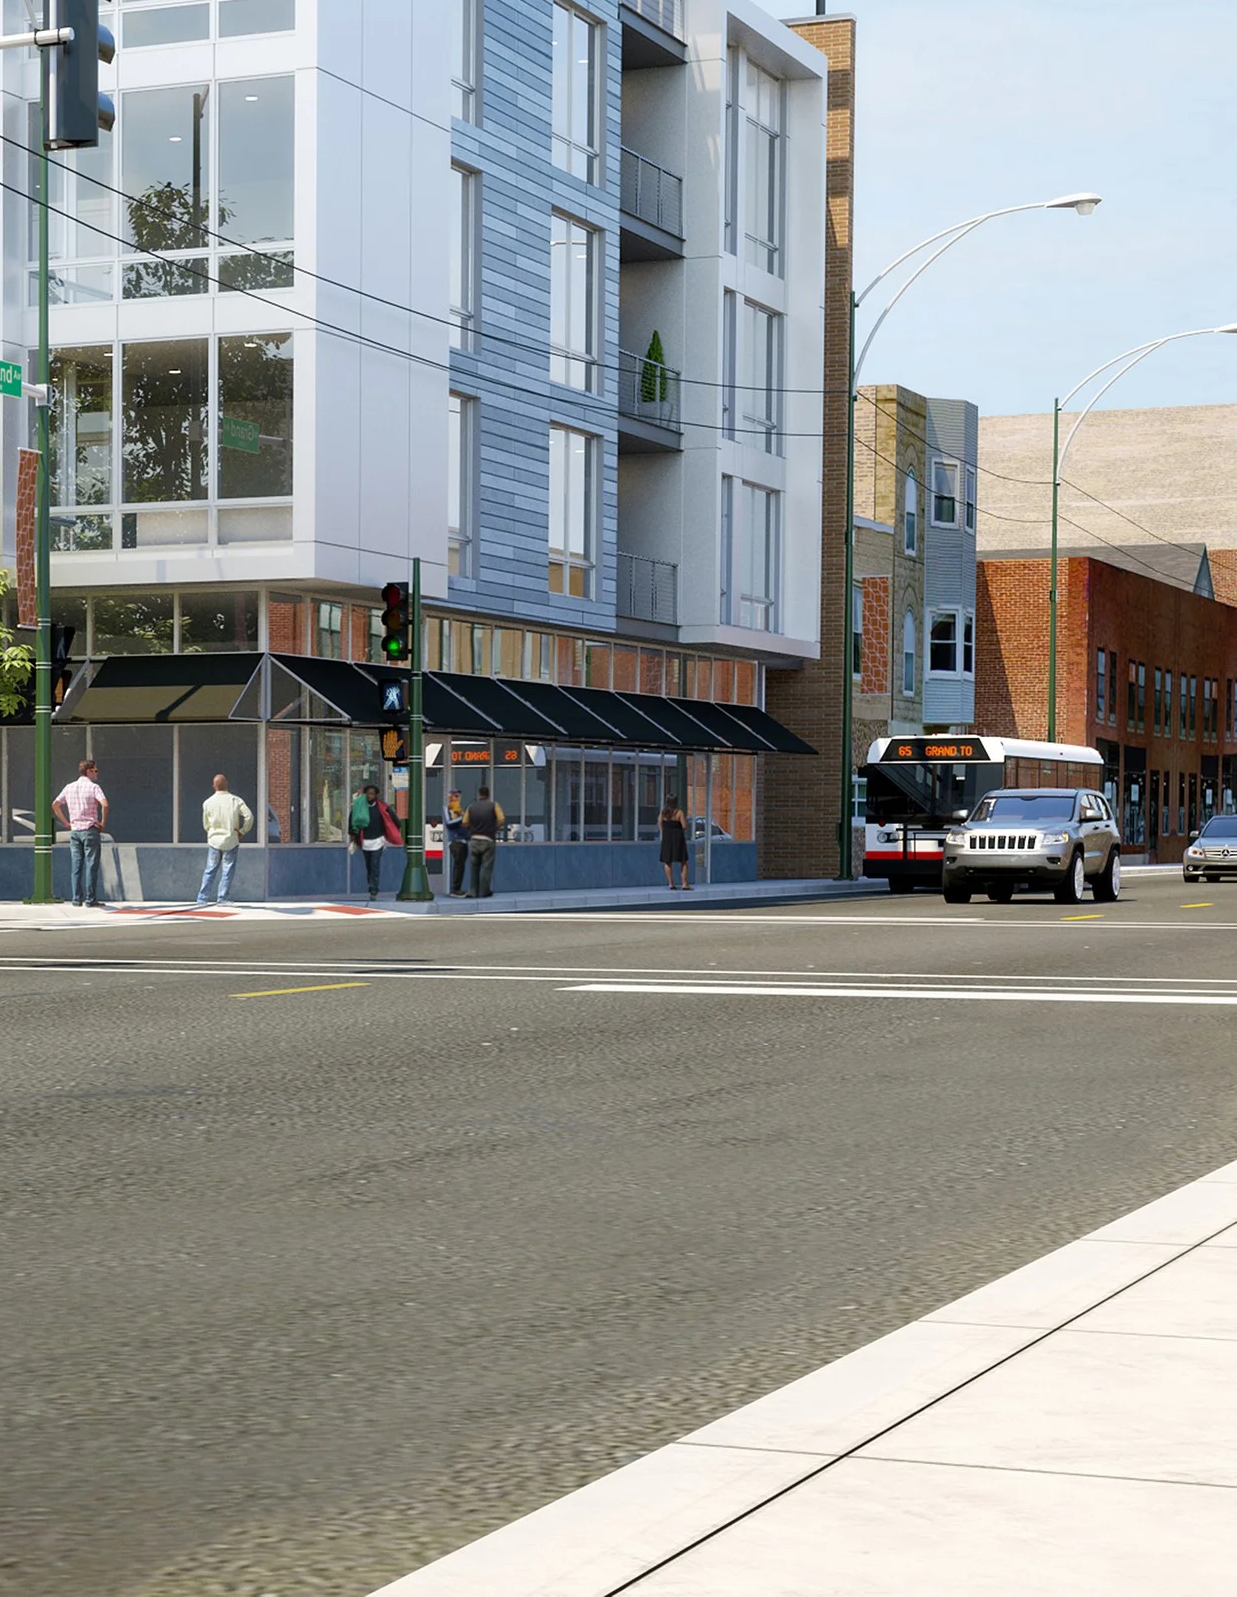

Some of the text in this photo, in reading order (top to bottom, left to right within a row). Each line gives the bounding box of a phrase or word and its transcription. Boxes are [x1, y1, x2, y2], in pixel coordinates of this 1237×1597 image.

[898, 746, 973, 756] 65 GRAND TO
